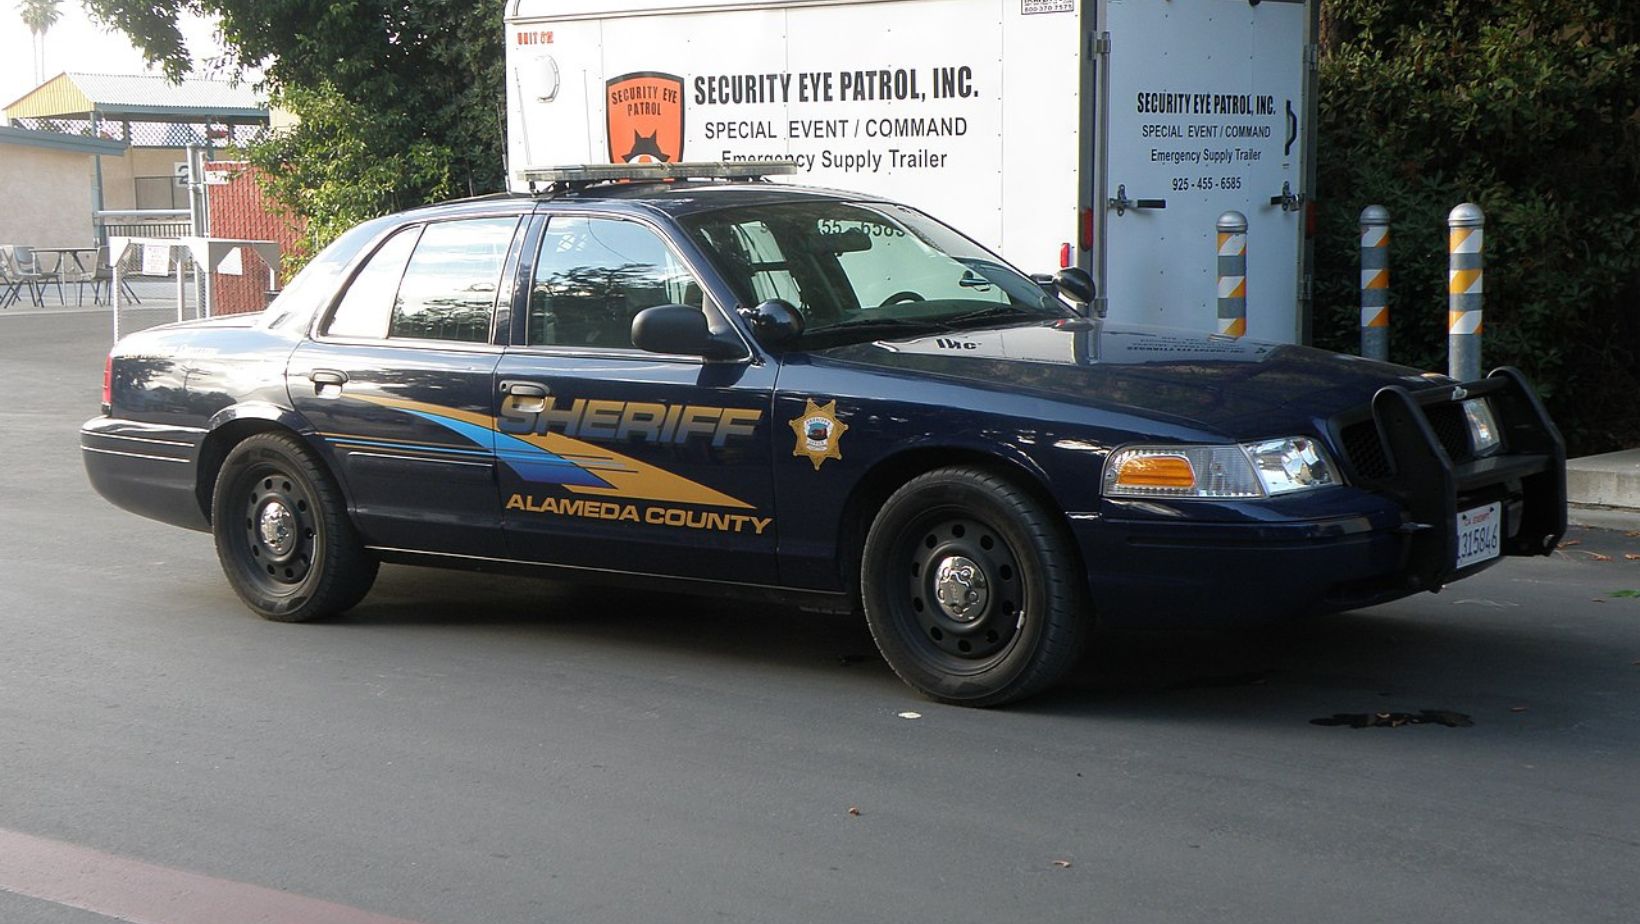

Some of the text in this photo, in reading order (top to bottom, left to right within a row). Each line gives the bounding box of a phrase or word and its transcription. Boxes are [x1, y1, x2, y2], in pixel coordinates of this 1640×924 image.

[517, 31, 538, 45] UNIT
[694, 65, 979, 105] SECURITY EYE PATROL, INC.
[611, 86, 678, 105] SECURITY EYE
[1137, 92, 1276, 116] SECURITY EYE PATROL, INC.
[627, 101, 661, 117] PATROL
[705, 117, 967, 139] SPECIAL EVENT / COMMAND
[1142, 124, 1183, 138] SPECIAL
[1188, 125, 1218, 138] EVENT
[1225, 125, 1271, 138] COMMAND
[821, 150, 882, 173] Supply
[888, 149, 948, 168] Trailer
[1151, 148, 1261, 165] Emergency Supply Trailer
[1172, 177, 1189, 191] 925
[1196, 177, 1213, 190] 455
[1220, 176, 1242, 190] 6585
[497, 395, 762, 447] SHERIFF
[506, 494, 773, 534] ALAMEDA COUNTY
